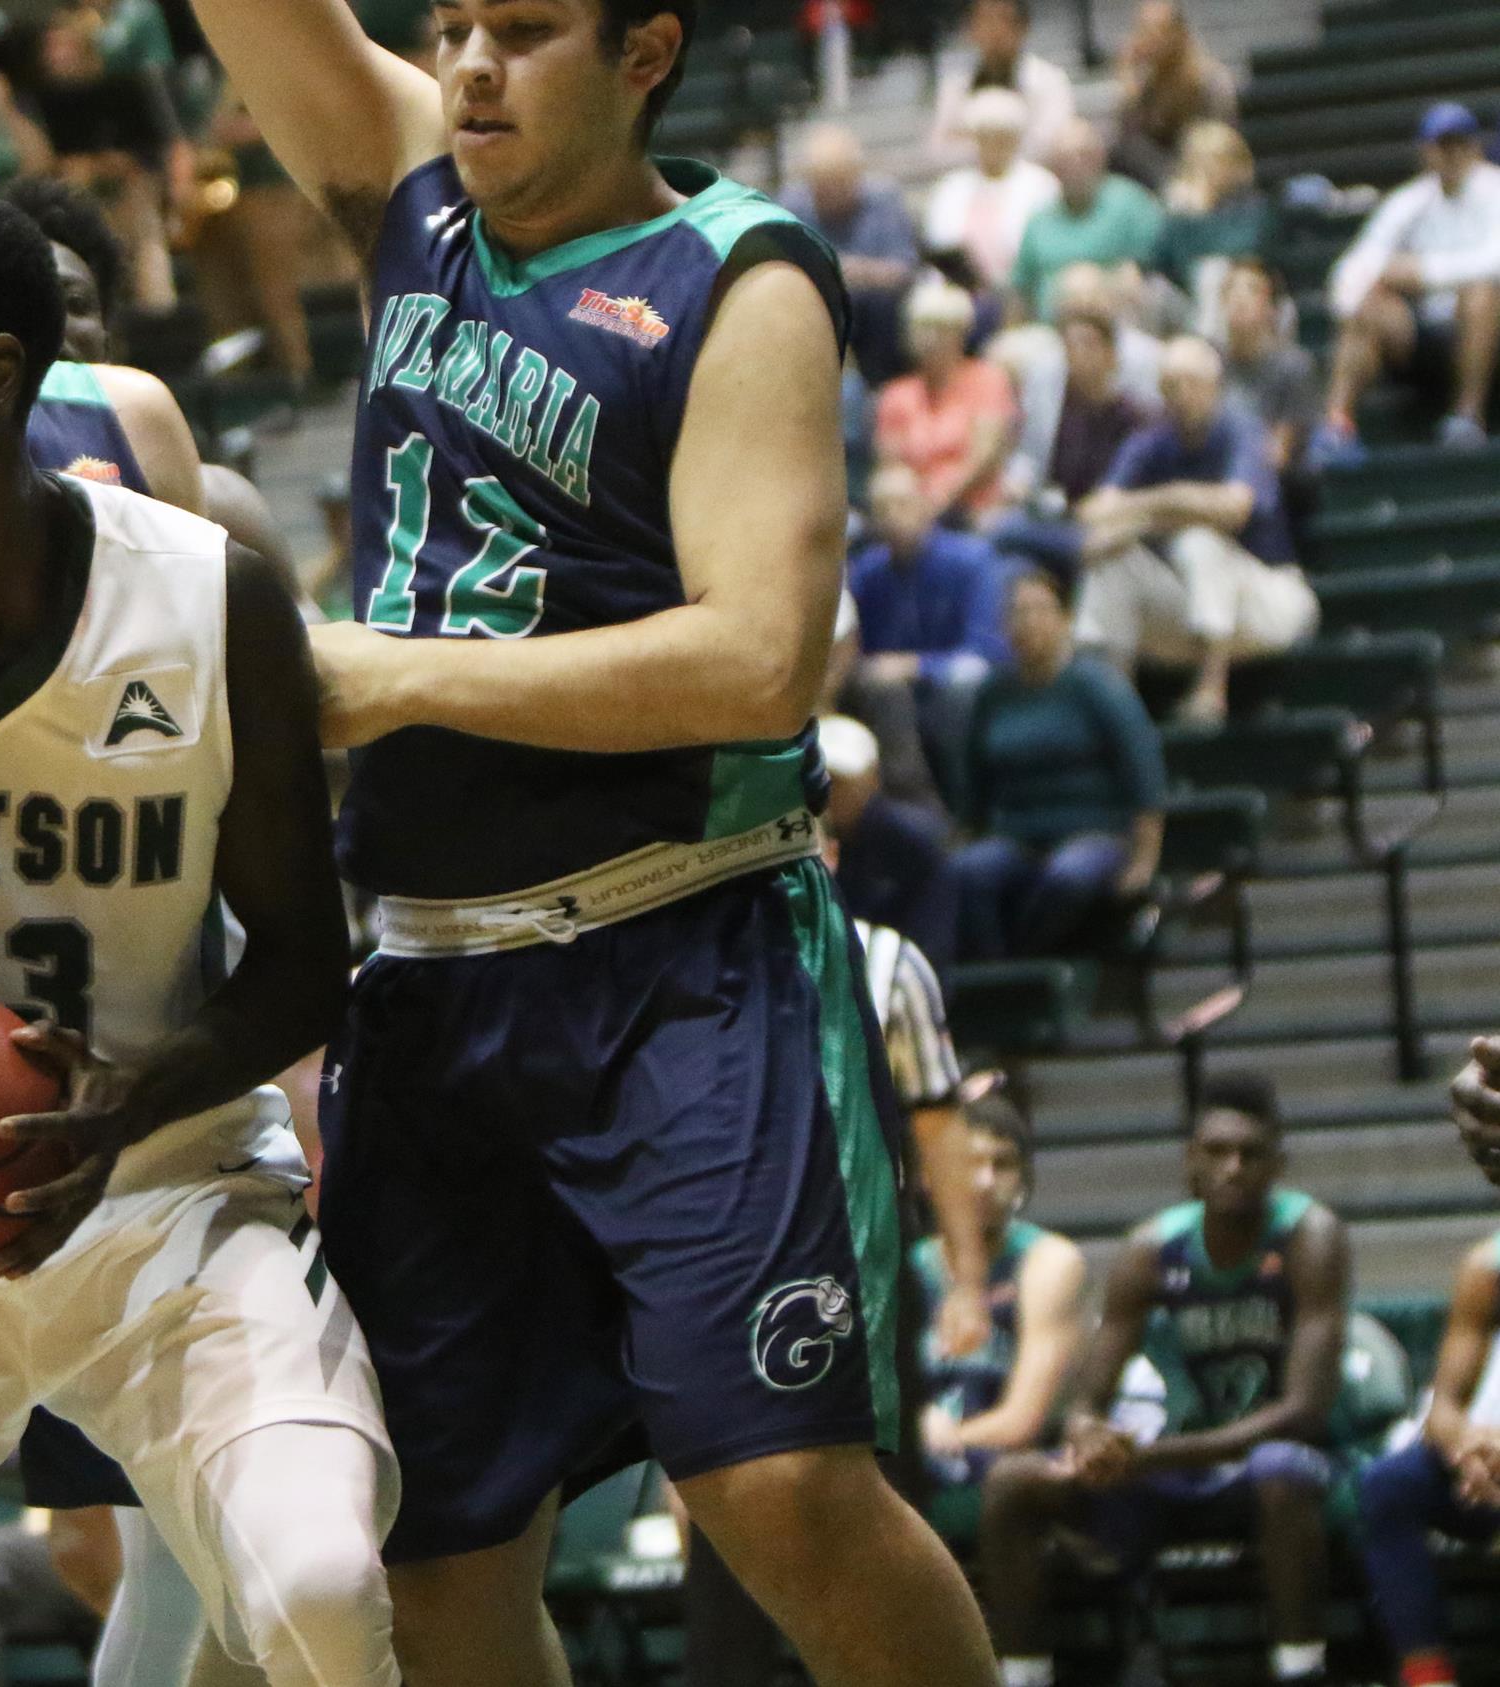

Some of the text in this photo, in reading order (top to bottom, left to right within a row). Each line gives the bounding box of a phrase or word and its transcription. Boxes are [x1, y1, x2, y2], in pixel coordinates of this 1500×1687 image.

[577, 287, 670, 337] The Sun
[434, 319, 601, 508] MARIA
[366, 431, 547, 640] 12
[588, 829, 772, 905] UNDER ARMOUR
